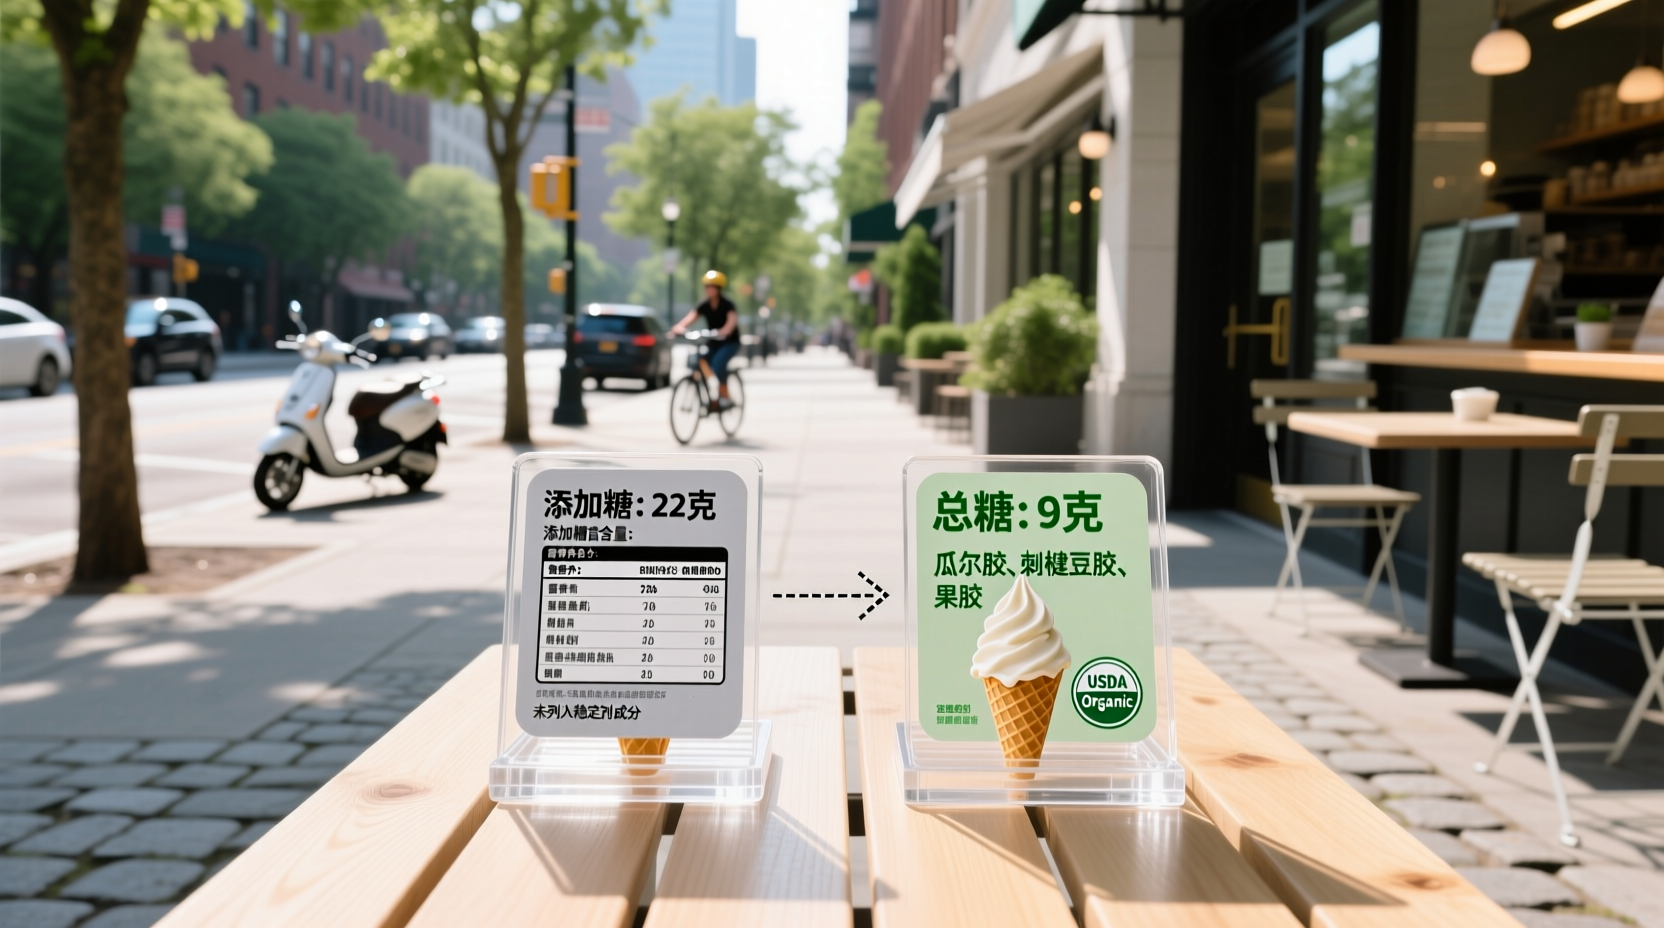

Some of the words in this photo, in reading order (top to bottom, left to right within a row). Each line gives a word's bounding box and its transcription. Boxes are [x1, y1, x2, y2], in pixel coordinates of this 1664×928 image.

[932, 489, 1104, 534] 总糖：9克
[934, 583, 983, 610] 果胶
[1087, 674, 1128, 690] USDA
[1081, 694, 1134, 712] Organic
